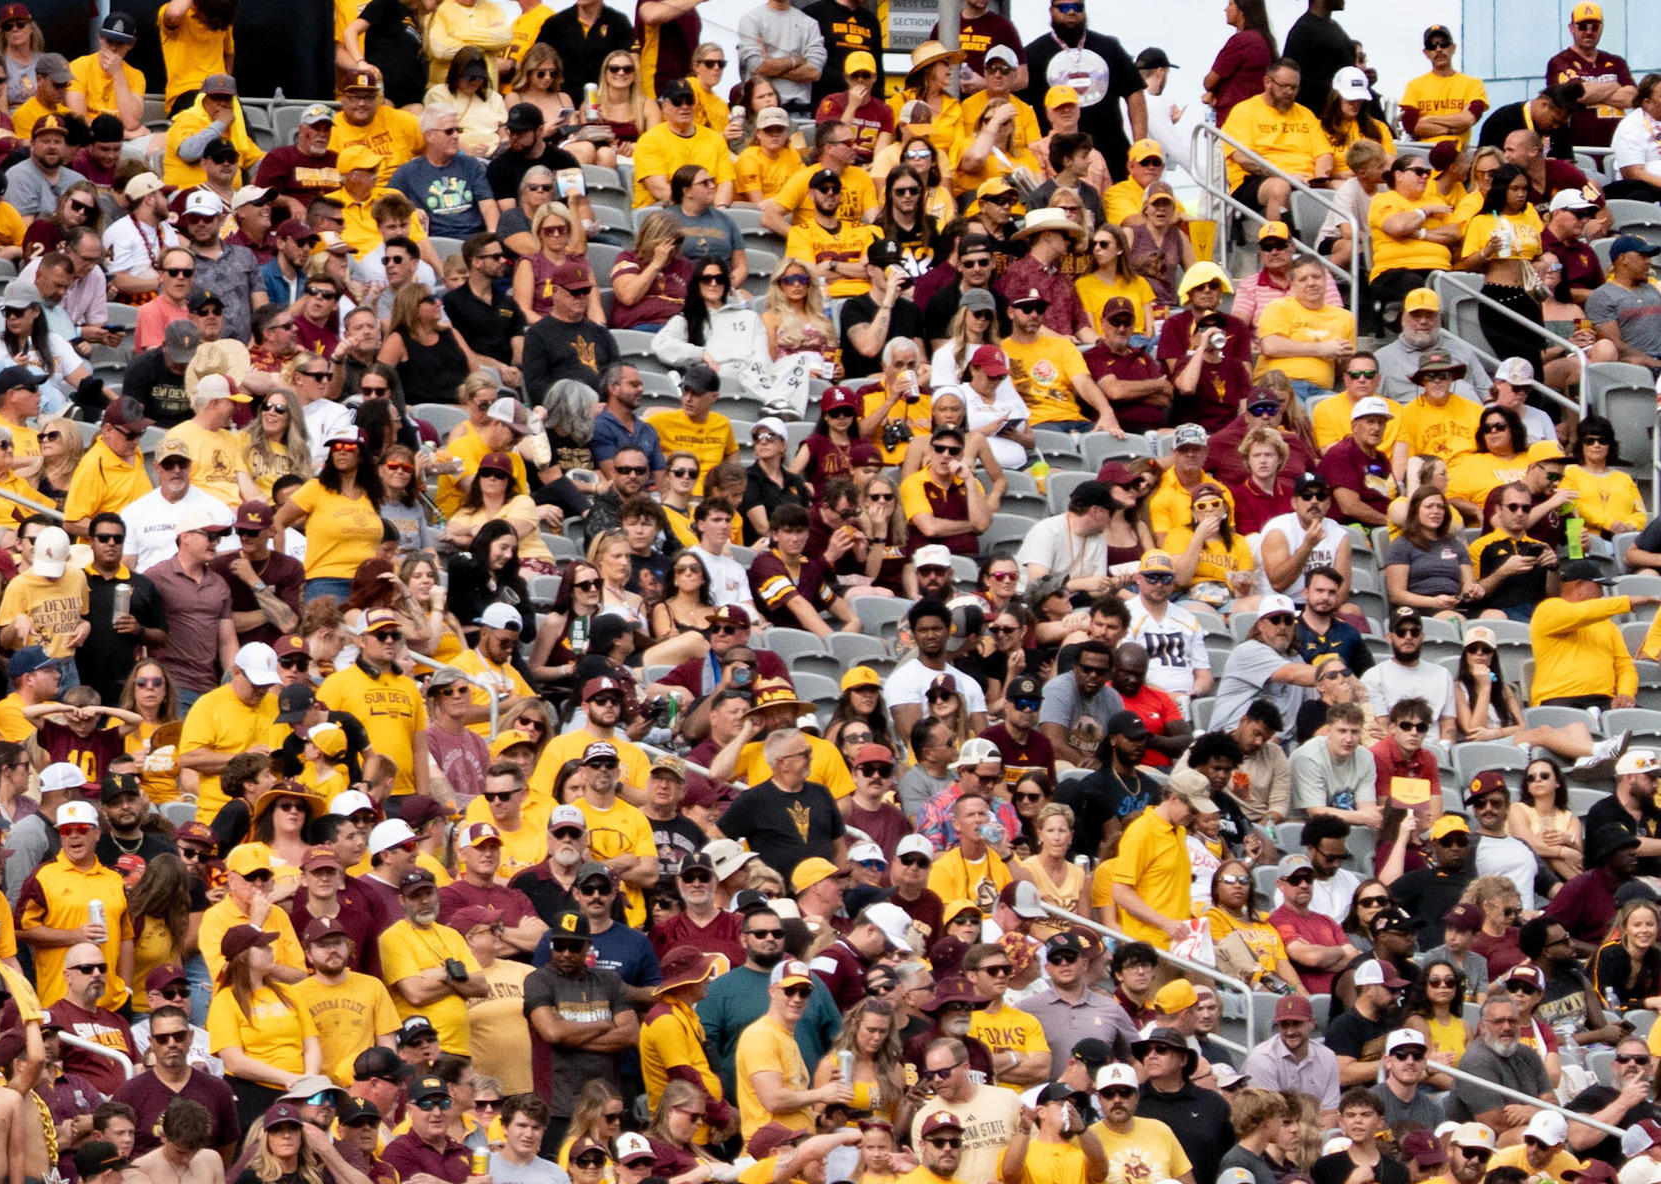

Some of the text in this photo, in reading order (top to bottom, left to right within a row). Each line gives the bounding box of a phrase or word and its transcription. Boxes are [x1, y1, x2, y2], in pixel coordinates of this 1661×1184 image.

[732, 321, 746, 332] 15
[364, 692, 386, 704] SUN
[340, 998, 366, 1015] STATE
[976, 1026, 1027, 1046] FORKS
[980, 1119, 1006, 1137] STATE
